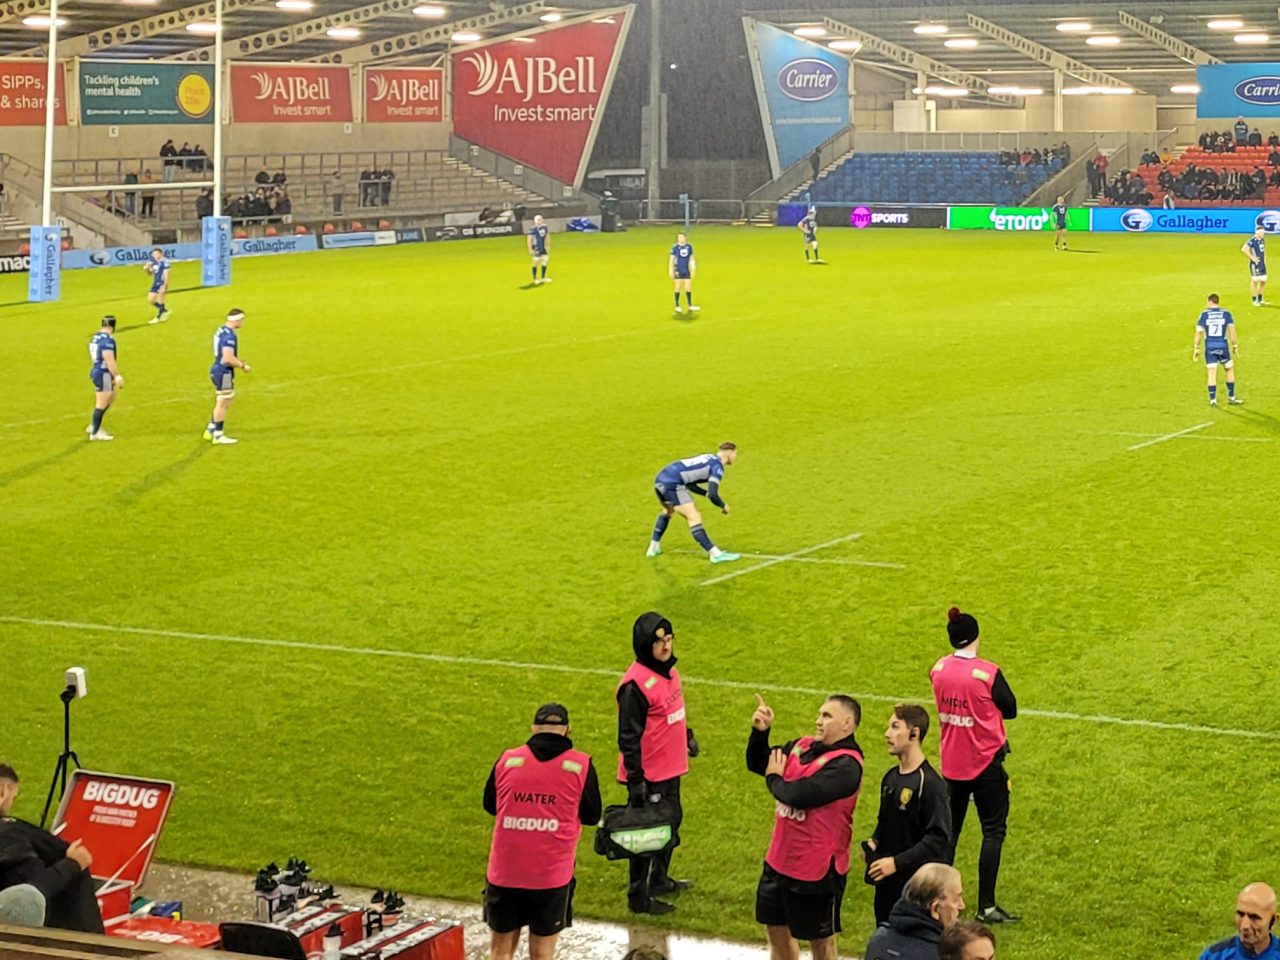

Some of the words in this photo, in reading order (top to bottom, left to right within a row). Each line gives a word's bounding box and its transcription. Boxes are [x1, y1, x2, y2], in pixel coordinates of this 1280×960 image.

[1, 74, 45, 90] SIPPs,
[84, 75, 119, 89] Tackling
[119, 75, 160, 86] children's
[785, 68, 834, 88] Carrier
[85, 87, 113, 96] mental
[115, 87, 141, 96] health
[15, 95, 60, 109] shars
[272, 105, 302, 116] Invest
[303, 105, 331, 116] smart
[386, 106, 412, 116] Invest
[414, 106, 440, 116] smart
[494, 104, 543, 122] Invest
[546, 104, 596, 121] smart
[871, 212, 909, 224] SPORTS
[1156, 214, 1229, 231] Gallagher
[242, 239, 297, 253] Gallagher
[82, 780, 161, 809] BIGDUG
[513, 791, 557, 806] WATER
